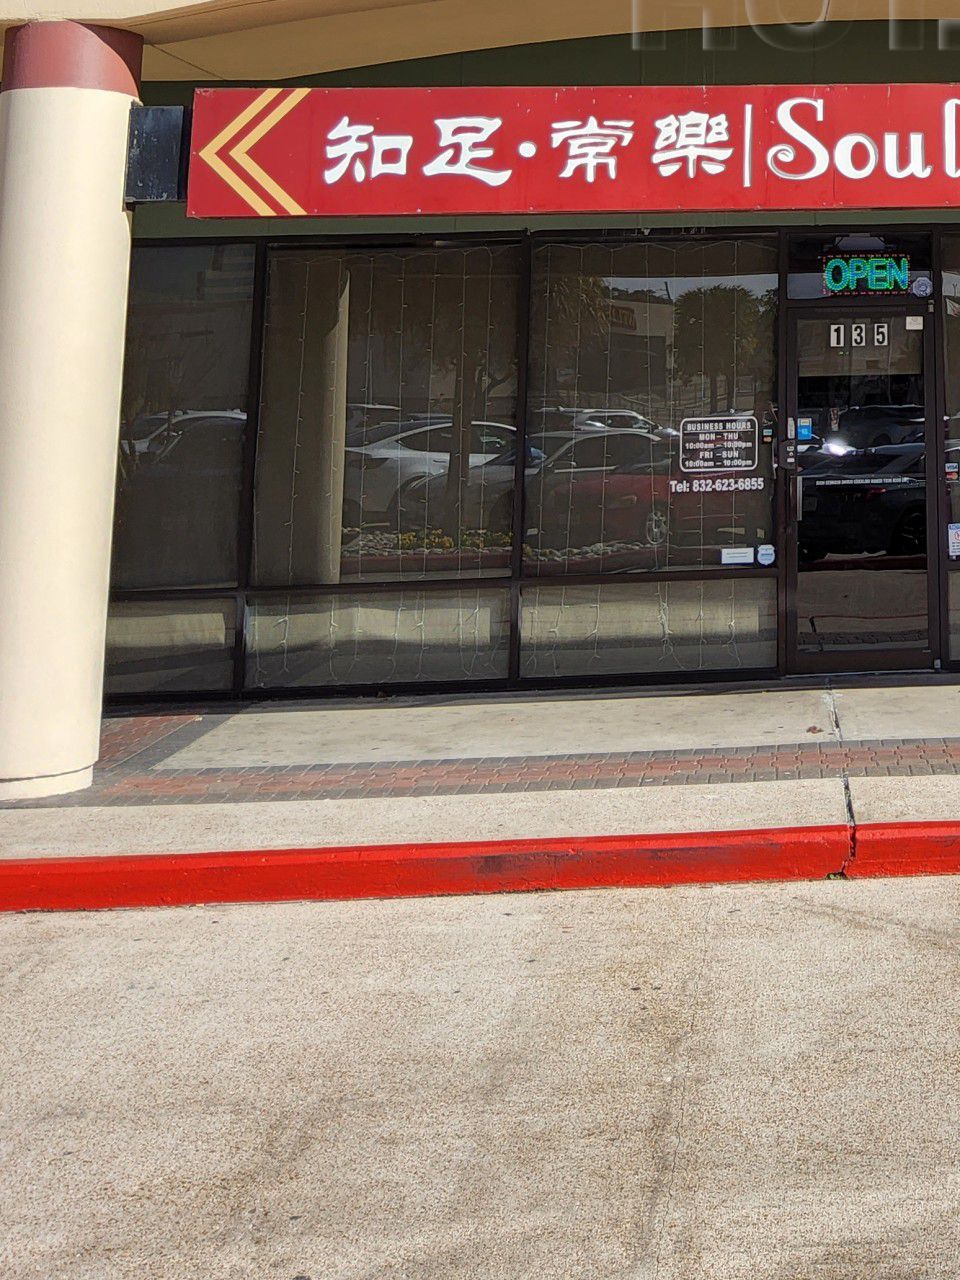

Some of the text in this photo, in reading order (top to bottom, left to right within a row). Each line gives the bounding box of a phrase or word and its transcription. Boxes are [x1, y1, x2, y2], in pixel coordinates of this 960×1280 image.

[825, 258, 909, 290] OPEN
[833, 325, 886, 346] 135
[687, 421, 751, 431] BUSINESS HOURS
[723, 432, 739, 440] THU
[700, 451, 713, 459] FRI
[722, 450, 739, 458] SUN
[669, 477, 764, 493] Tel: 832-623-6855
